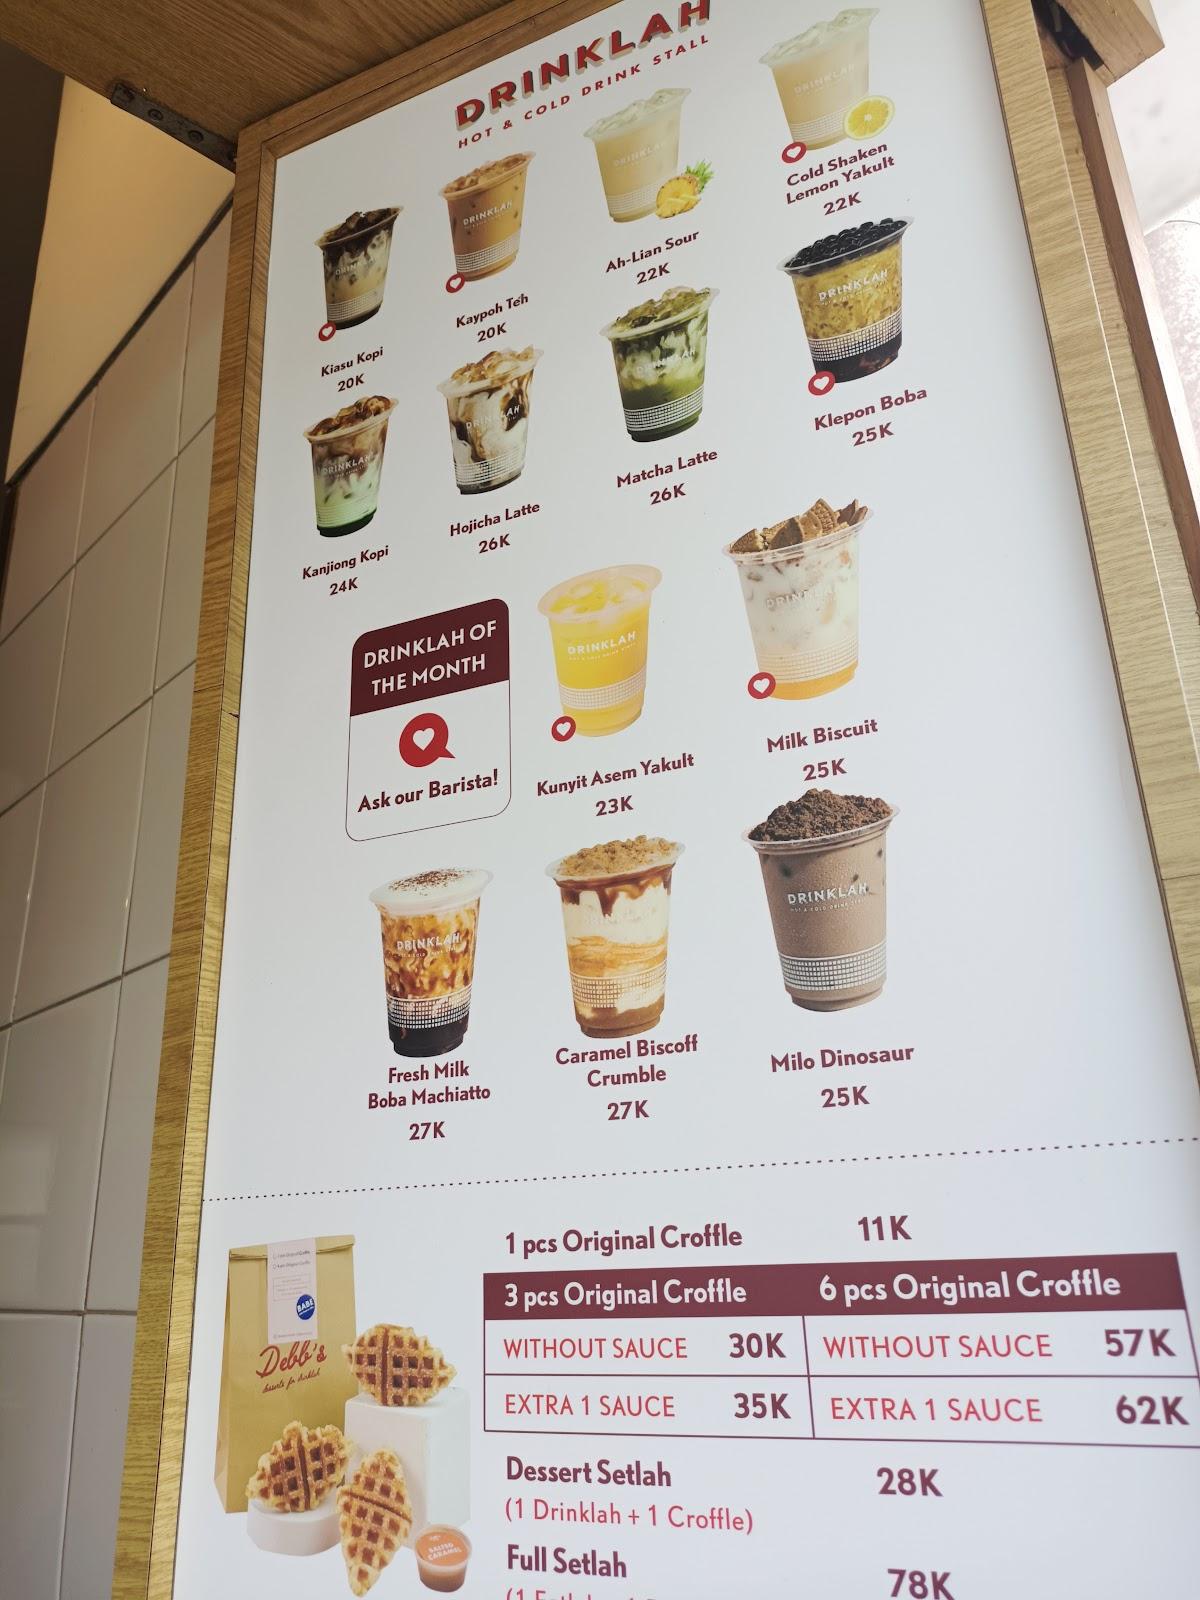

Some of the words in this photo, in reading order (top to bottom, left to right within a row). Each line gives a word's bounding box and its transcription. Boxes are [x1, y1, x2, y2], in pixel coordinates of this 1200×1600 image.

[455, 0, 710, 131] DRINKLAH
[459, 128, 492, 148] HOT
[503, 120, 512, 129] &
[524, 96, 570, 120] COLD
[582, 64, 640, 96] DRINK
[652, 35, 708, 65] STALL
[787, 164, 824, 186] Cold
[828, 144, 888, 171] Shaken
[787, 180, 838, 204] Lemon
[842, 156, 894, 182] Yakult
[824, 192, 861, 215] 22K
[606, 247, 661, 272] Ah-Lian
[665, 232, 699, 250] Sour
[637, 263, 670, 284] 22K
[819, 269, 888, 301] DRINKLAH
[457, 303, 502, 330] Kaypoh
[478, 323, 506, 342] 20K
[322, 360, 353, 377] Kiasu
[357, 347, 383, 364] Kopi
[338, 374, 364, 392] 20K
[815, 406, 875, 430] Klepon
[880, 390, 927, 410] Boba
[852, 422, 893, 446] 25K
[617, 464, 673, 488] Matcha
[678, 452, 717, 470] Latte
[650, 483, 686, 505] 26K
[451, 515, 500, 536] Hojicha
[506, 504, 539, 520] Latte
[479, 534, 510, 553] 26K
[303, 558, 356, 579] Kanjiong
[361, 545, 388, 562] Kopi
[330, 577, 358, 595] 24K
[364, 628, 464, 668] DRINKLAH
[470, 620, 496, 640] OF
[567, 631, 637, 655] DRINKLAH
[372, 673, 406, 695] THE
[413, 654, 485, 686] MONTH
[767, 732, 808, 752] Milk
[813, 720, 878, 744] Biscuit
[538, 776, 587, 796] Kunyit
[591, 769, 636, 786] Asem
[640, 753, 694, 775] Yakult
[803, 758, 847, 781] 25K
[358, 792, 390, 812] Ask
[395, 790, 423, 804] our
[429, 768, 497, 798] Barista!
[596, 795, 633, 816] 23K
[787, 882, 868, 905] DRINKLAH
[396, 932, 461, 951] DRINKLAH
[556, 1041, 631, 1064] Caramel
[637, 1034, 697, 1057] Biscoff
[771, 1052, 815, 1072] Milo
[820, 1048, 914, 1068] Dinosaur
[389, 1065, 429, 1083] Fresh
[435, 1060, 469, 1079] Milk
[588, 1064, 666, 1087] Crumble
[369, 1092, 406, 1109] Boba
[412, 1086, 490, 1105] Machiatto
[608, 1100, 649, 1120] 27K
[821, 1086, 870, 1108] 25K
[409, 1121, 445, 1140] 27K
[506, 1232, 514, 1254] 1
[524, 1239, 557, 1259] pcs
[563, 1226, 655, 1256] Original
[661, 1223, 742, 1248] Croffle
[858, 1215, 912, 1241] 11K
[505, 1284, 518, 1306] 3
[524, 1291, 558, 1312] pcs
[564, 1280, 657, 1311] Original
[664, 1278, 746, 1303] Croffle
[820, 1275, 836, 1300] 6
[844, 1284, 887, 1307] pcs
[893, 1271, 1010, 1305] Original
[1017, 1268, 1120, 1297] Croffle
[297, 1299, 315, 1313] BABE
[504, 1338, 606, 1358] WITHOUT
[613, 1338, 687, 1358] SAUCE
[729, 1333, 786, 1358] 30K
[823, 1336, 950, 1358] WITHOUT
[959, 1335, 1052, 1357] SAUCE
[1105, 1329, 1176, 1356] 57K
[256, 1340, 327, 1378] Debb's
[506, 1394, 573, 1415] EXTRA
[582, 1395, 588, 1415] 1
[600, 1395, 675, 1417] SAUCE
[734, 1393, 791, 1419] 35K
[831, 1398, 916, 1420] EXTRA
[926, 1399, 935, 1420] 1
[948, 1398, 1042, 1422] SAUCE
[1116, 1396, 1189, 1425] 62K
[507, 1456, 592, 1483] Dessert
[597, 1459, 671, 1486] Setlah
[877, 1467, 942, 1496] 28K
[506, 1498, 522, 1522] (1
[534, 1499, 620, 1524] Drinklah
[628, 1509, 639, 1524] +
[649, 1505, 656, 1526] 1
[668, 1506, 752, 1535] Croffle)
[508, 1544, 546, 1572] Full
[554, 1547, 626, 1577] Setlah
[888, 1569, 954, 1600] 78K
